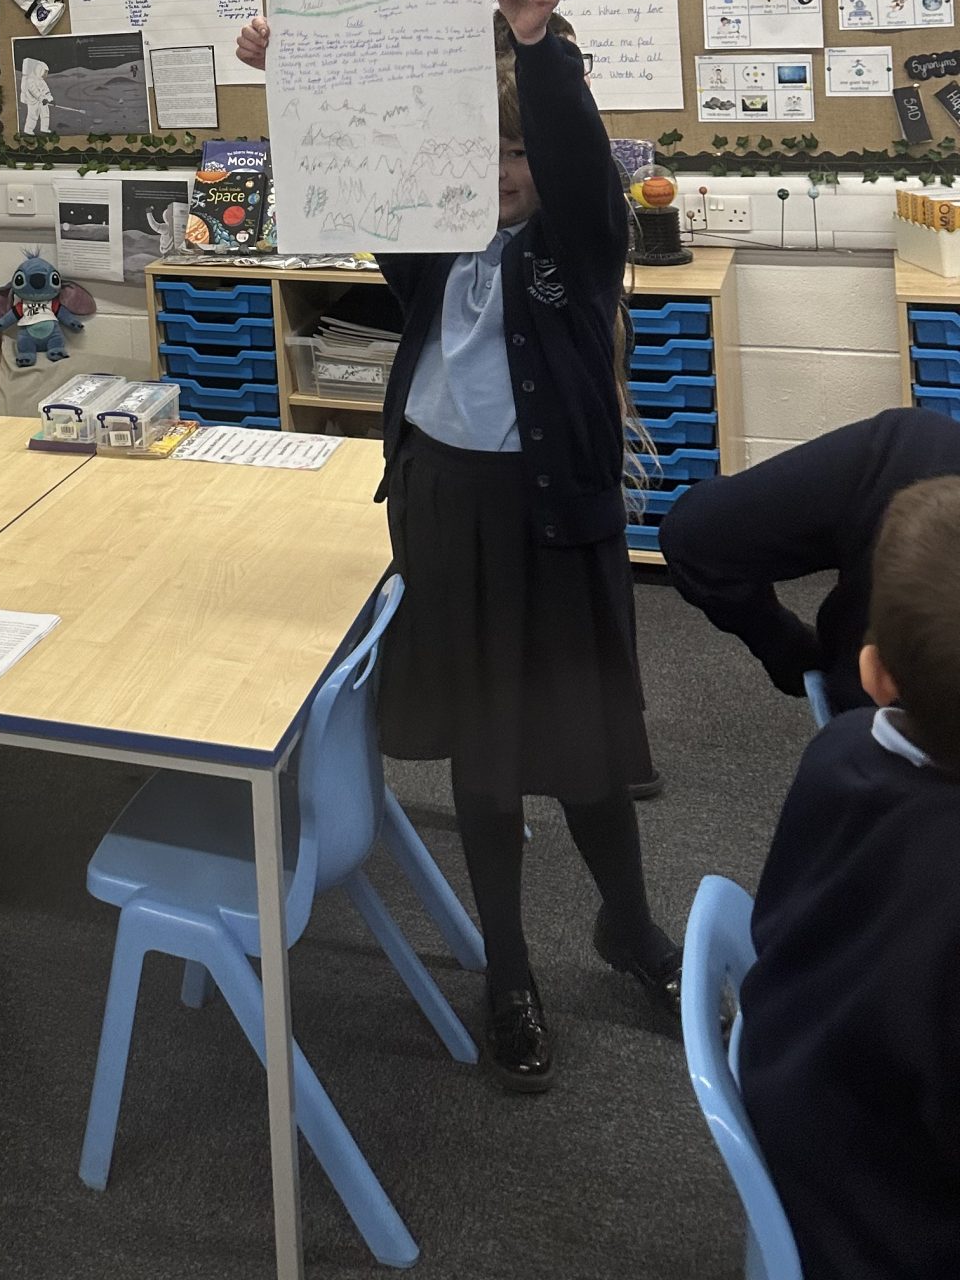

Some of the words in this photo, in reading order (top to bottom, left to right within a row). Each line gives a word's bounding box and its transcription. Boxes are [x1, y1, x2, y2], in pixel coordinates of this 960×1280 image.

[581, 8, 592, 16] is
[627, 7, 641, 22] my
[648, 3, 664, 14] love
[620, 39, 633, 47] me
[638, 36, 655, 49] feel
[620, 53, 640, 63] that
[647, 52, 663, 62] all
[911, 58, 958, 78] Synonyms
[904, 98, 921, 121] SAD
[227, 156, 264, 166] MOON
[207, 188, 246, 205] Space
